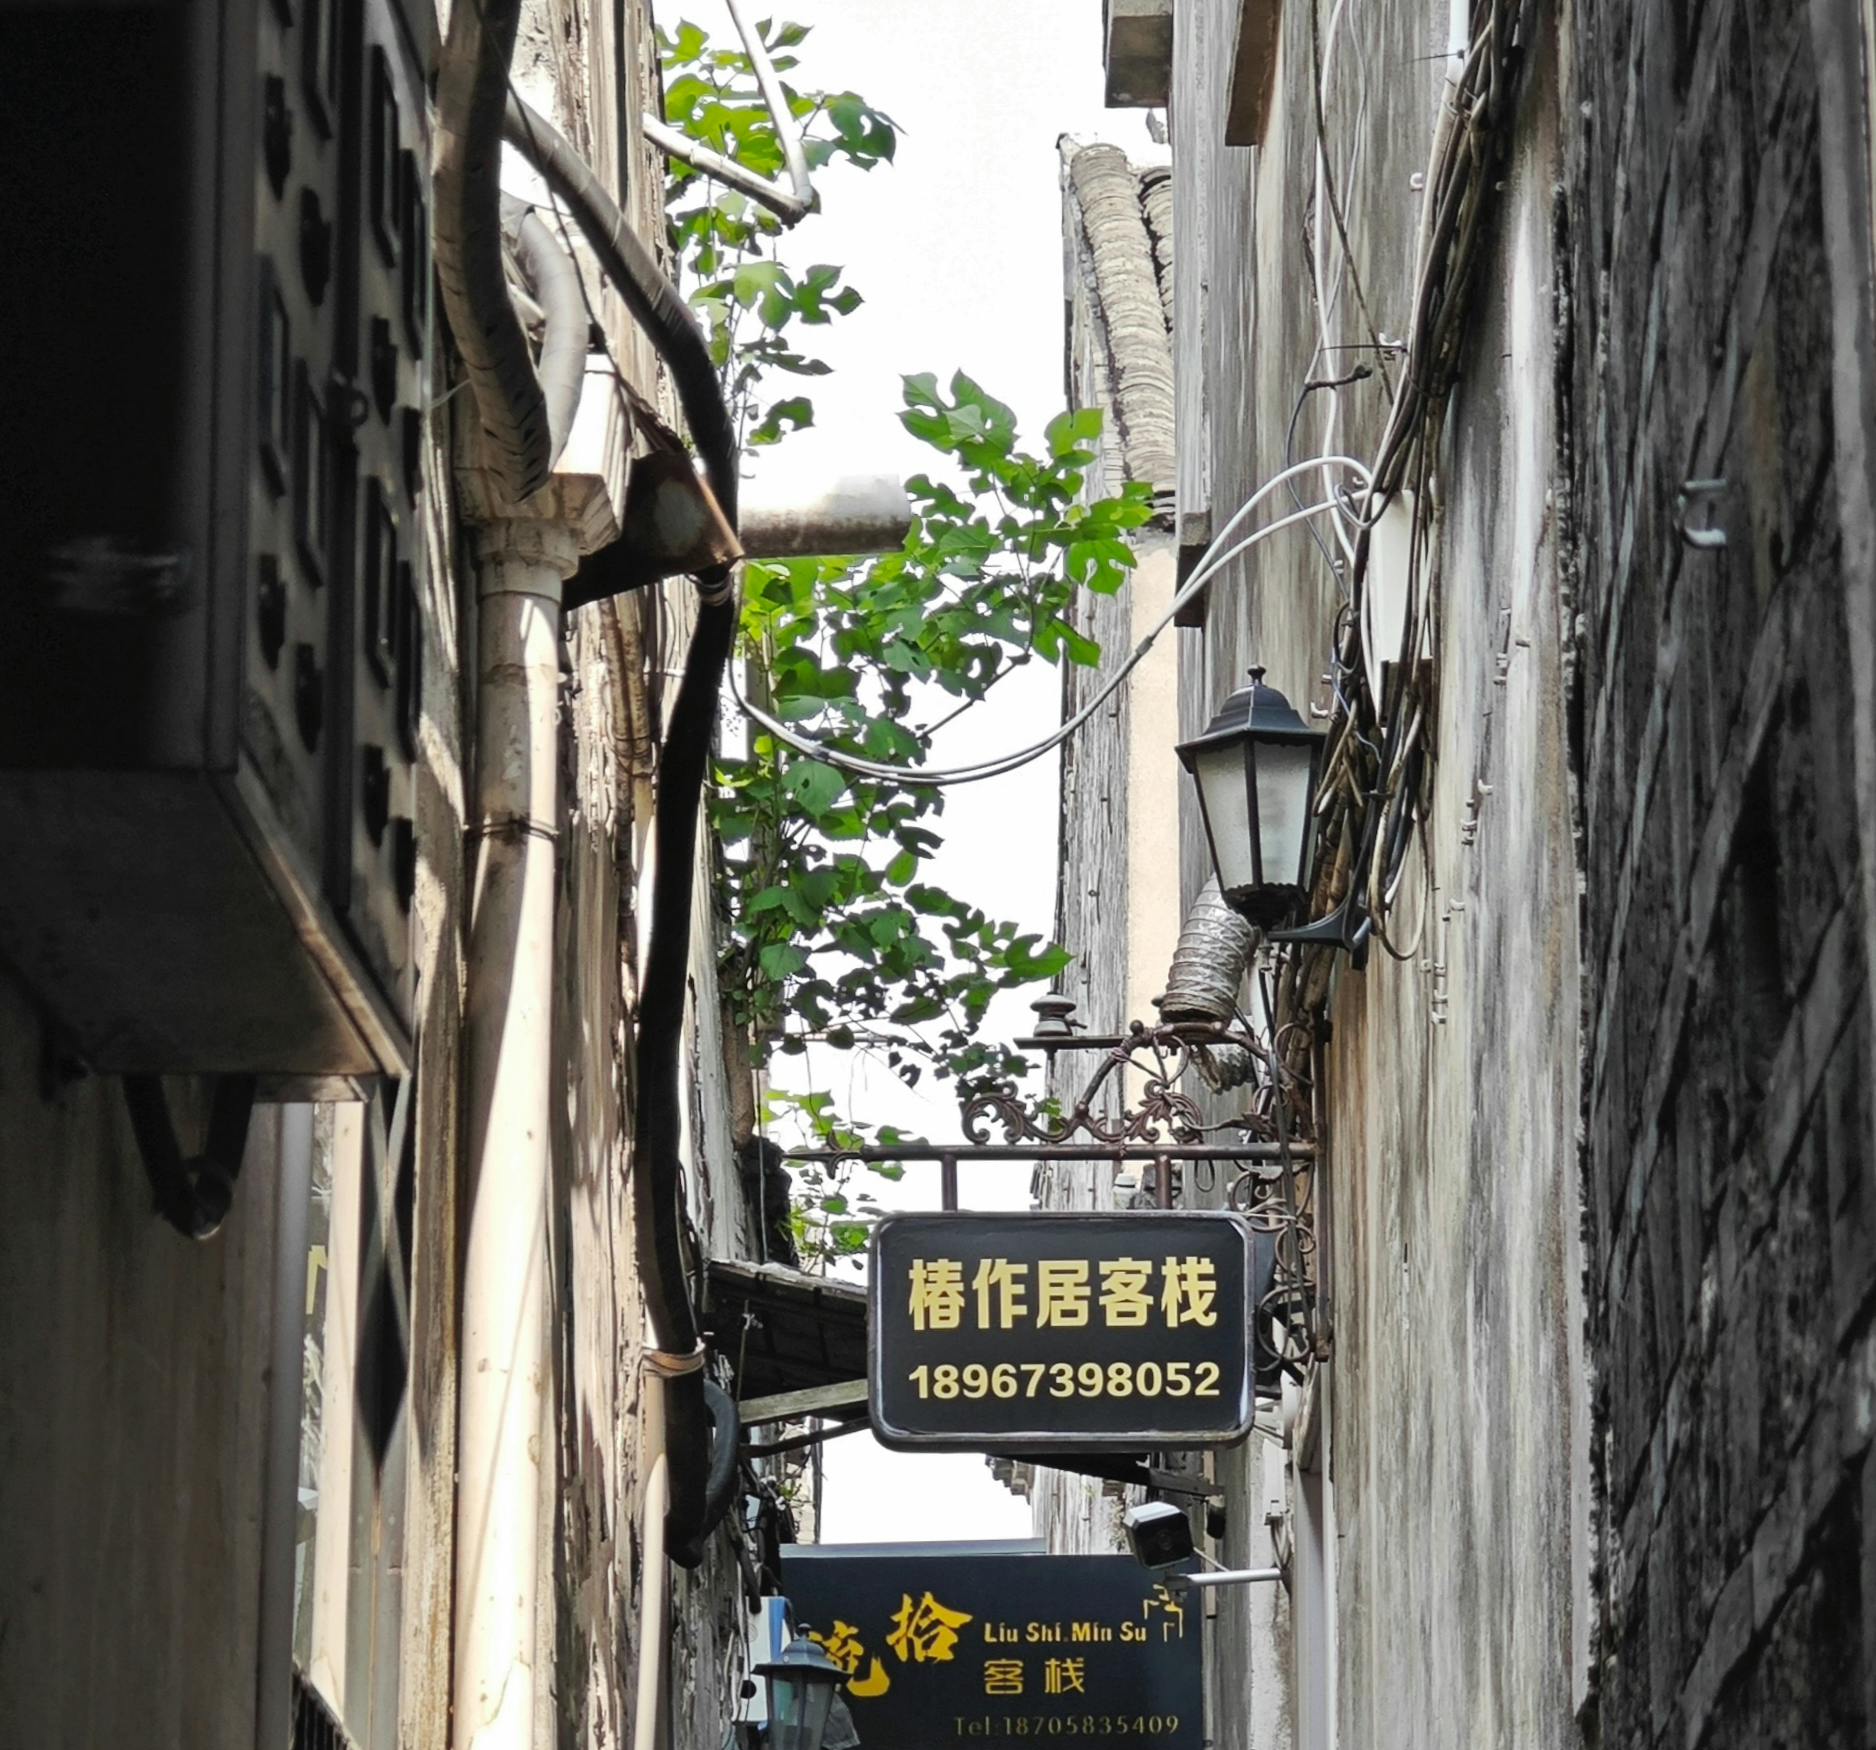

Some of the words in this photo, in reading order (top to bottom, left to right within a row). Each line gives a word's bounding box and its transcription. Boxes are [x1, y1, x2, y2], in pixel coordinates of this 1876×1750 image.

[908, 1256, 1217, 1331] 椿作居客栈
[908, 1361, 1220, 1399] 18967398052
[984, 1621, 1019, 1643] Liu
[1119, 1620, 1147, 1642] Su
[983, 1657, 1085, 1695] 客栈
